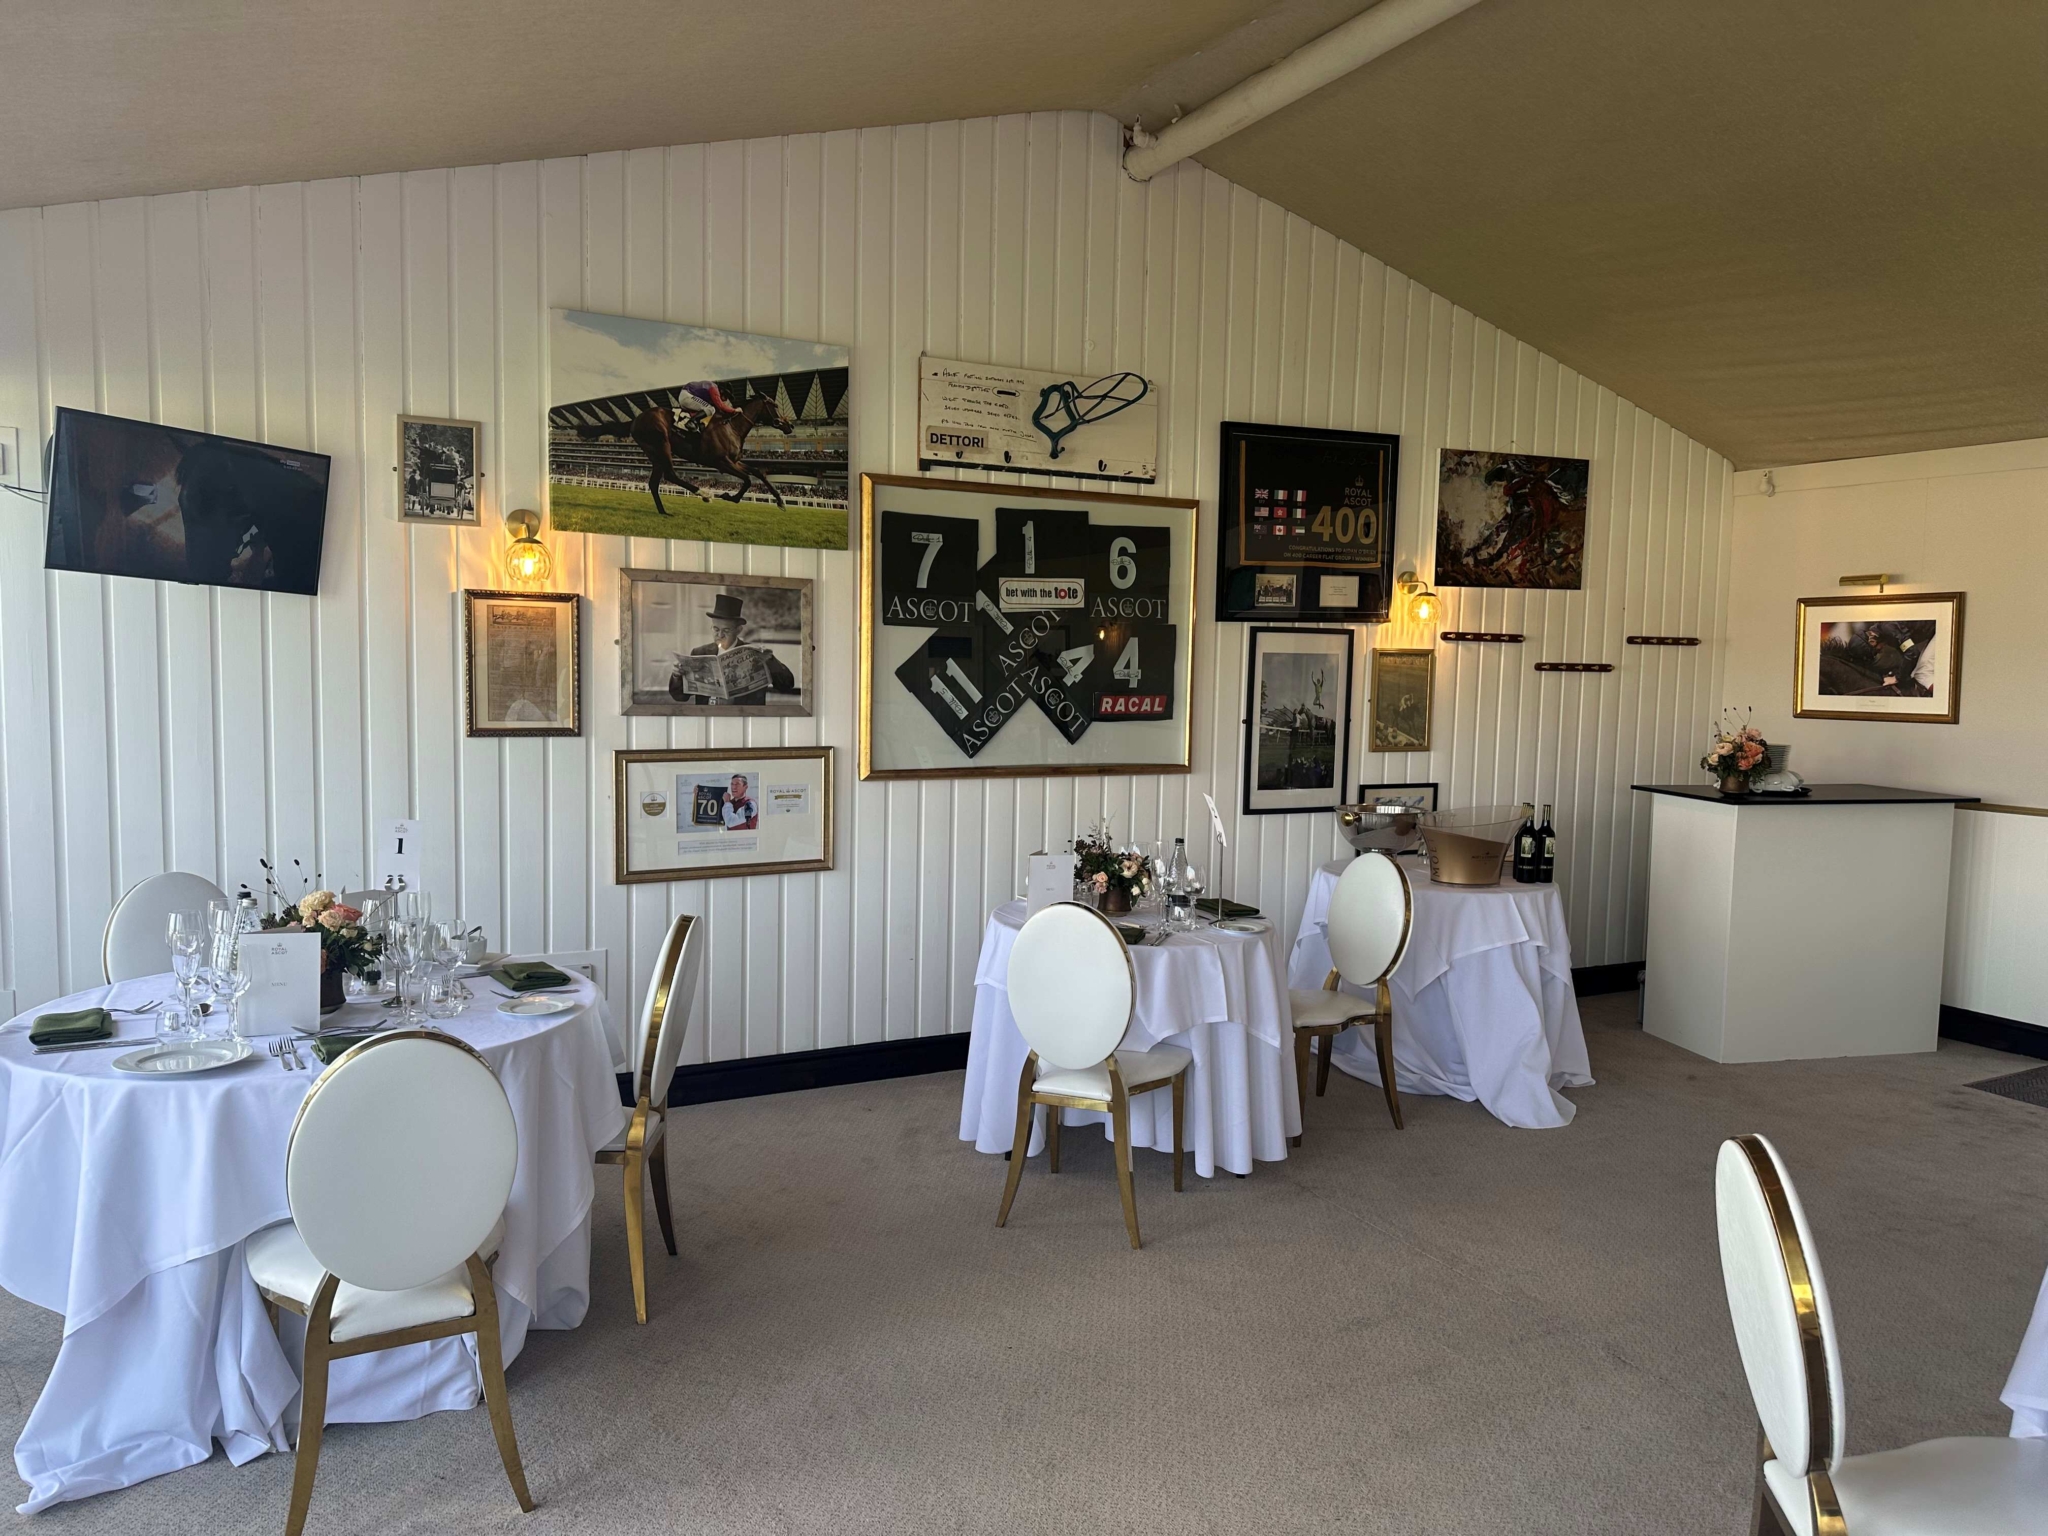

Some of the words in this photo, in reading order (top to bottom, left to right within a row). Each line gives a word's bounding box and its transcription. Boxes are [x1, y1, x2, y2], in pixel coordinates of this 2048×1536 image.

[930, 432, 984, 448] DETTORI
[1343, 497, 1372, 507] ASCOT
[1344, 487, 1372, 498] ROYAL
[1311, 505, 1377, 545] 400
[911, 531, 943, 589] 7
[1022, 520, 1035, 574] 1
[1109, 536, 1137, 589] 6
[886, 595, 975, 623] ASCOT
[1006, 586, 1018, 598] bet
[1020, 587, 1038, 598] with
[1040, 588, 1052, 598] the
[1054, 586, 1078, 600] tote
[1090, 596, 1167, 619] ASCOT
[1056, 643, 1095, 688] 4
[1113, 636, 1142, 689] 4
[930, 657, 983, 720] 11
[1020, 665, 1088, 734] ASCOT
[1101, 697, 1164, 713] RACAL
[962, 678, 1027, 755] ASCOT
[697, 799, 718, 816] 70
